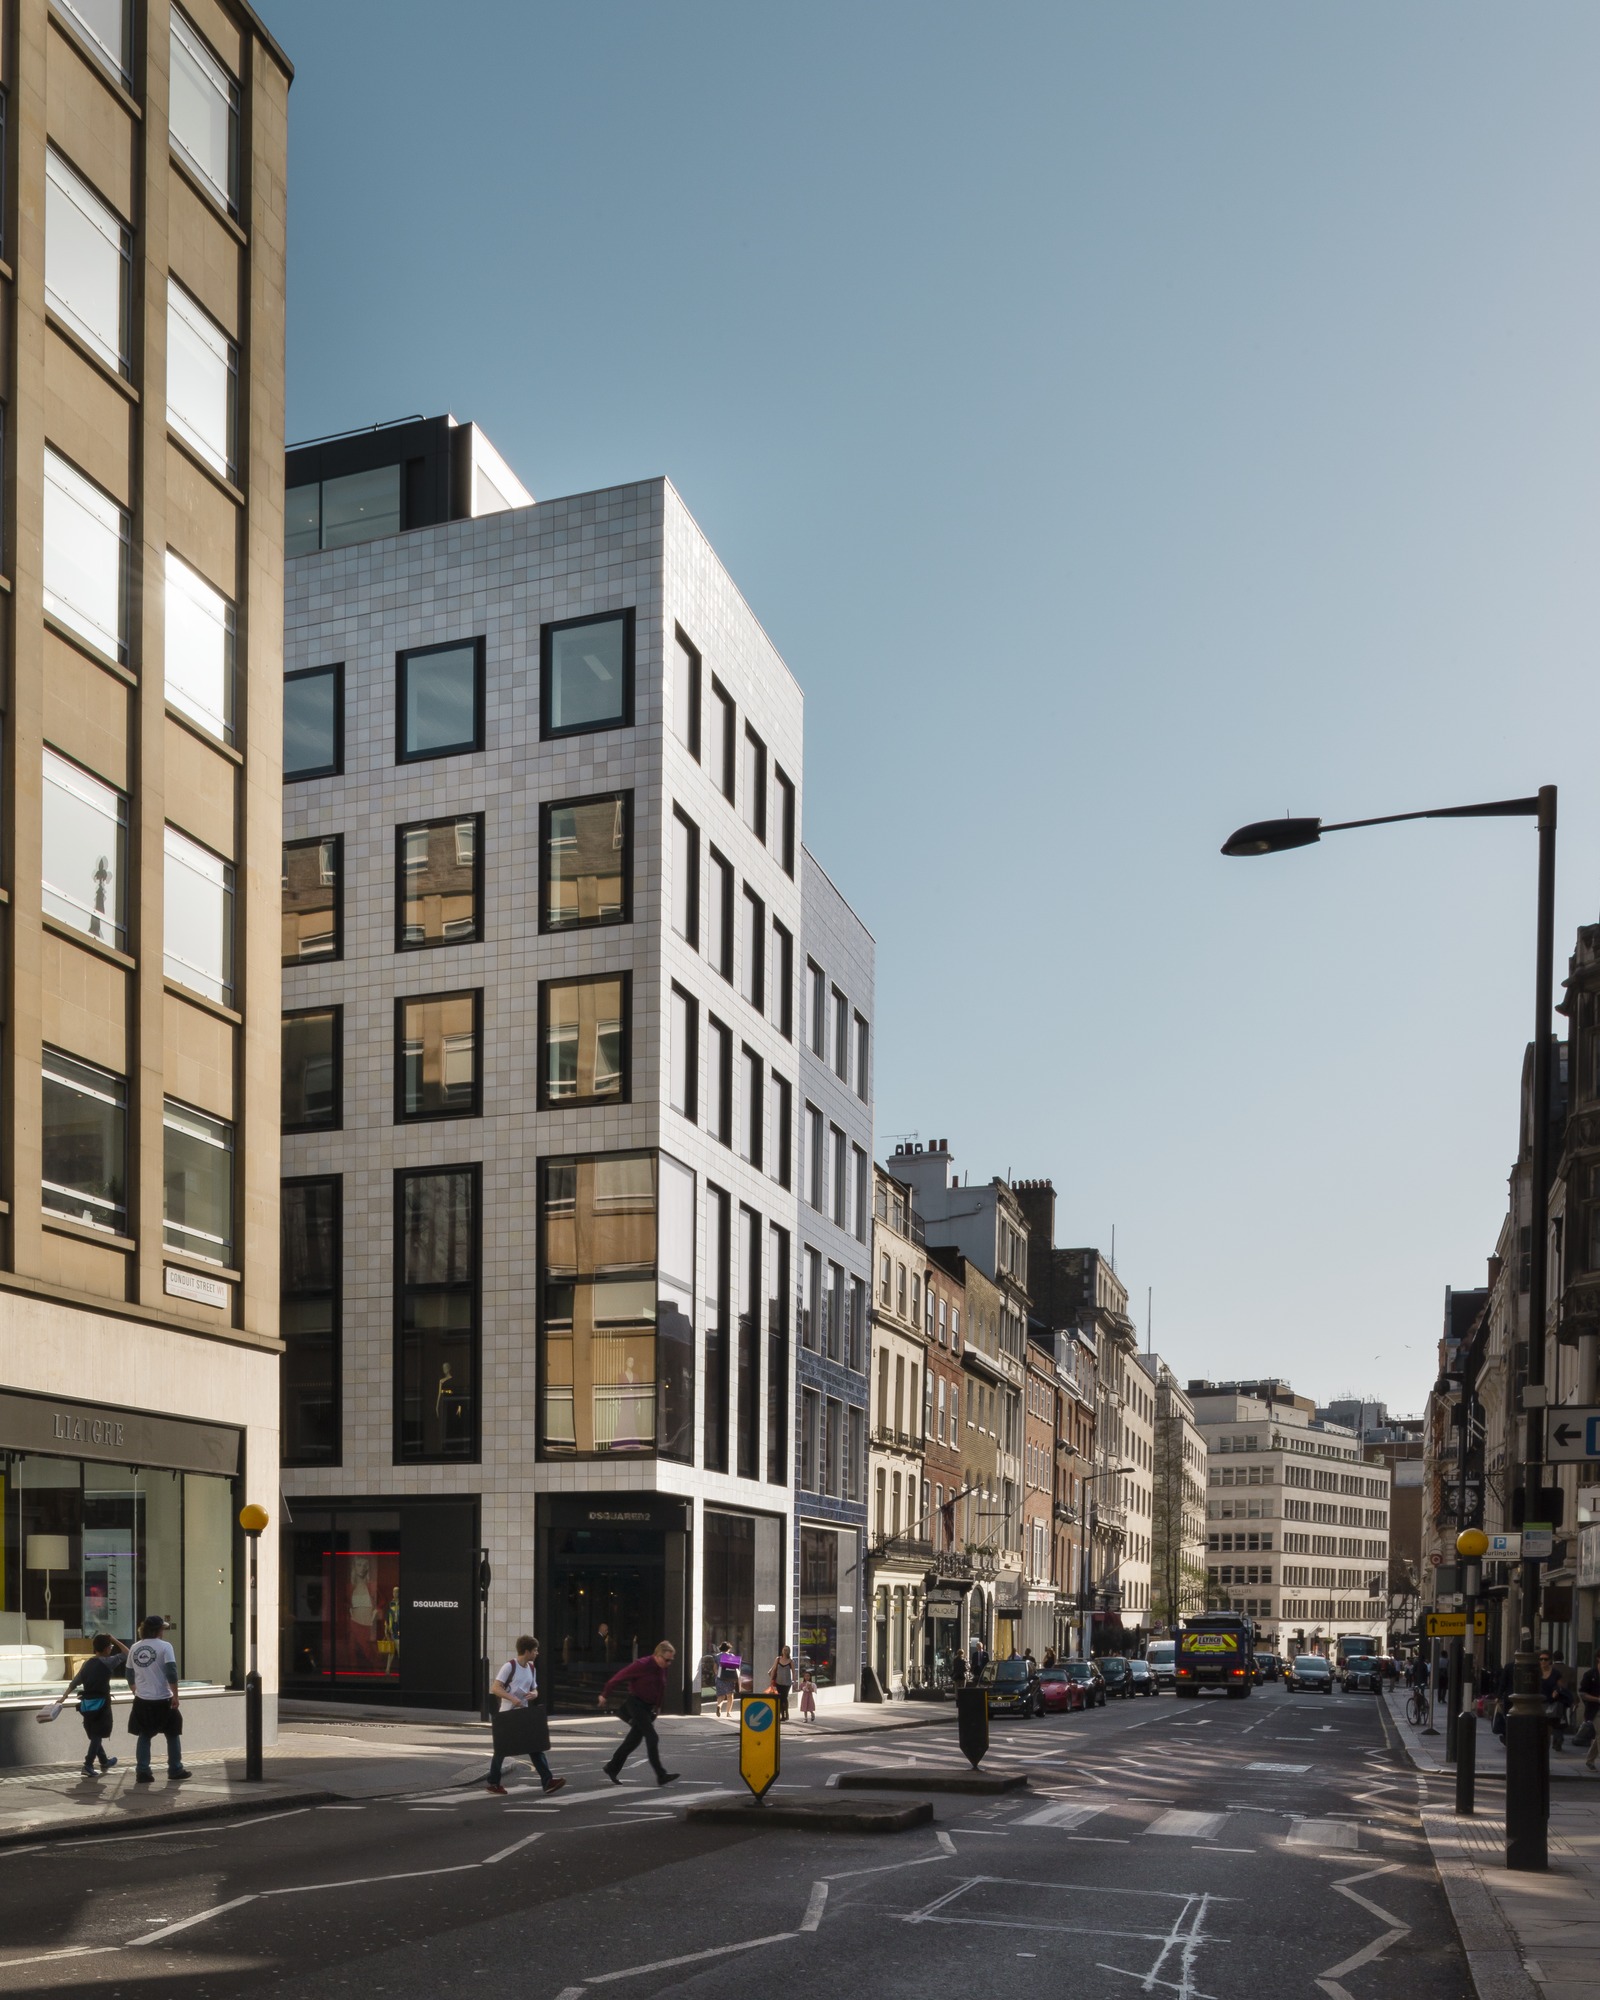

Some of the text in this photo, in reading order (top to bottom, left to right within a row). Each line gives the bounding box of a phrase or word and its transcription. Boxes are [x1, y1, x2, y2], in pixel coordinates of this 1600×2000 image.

[170, 1272, 195, 1287] CONDUIT
[196, 1280, 215, 1293] STREET
[53, 1413, 124, 1447] LIAIGRE
[588, 1511, 651, 1520] DSQUARED2
